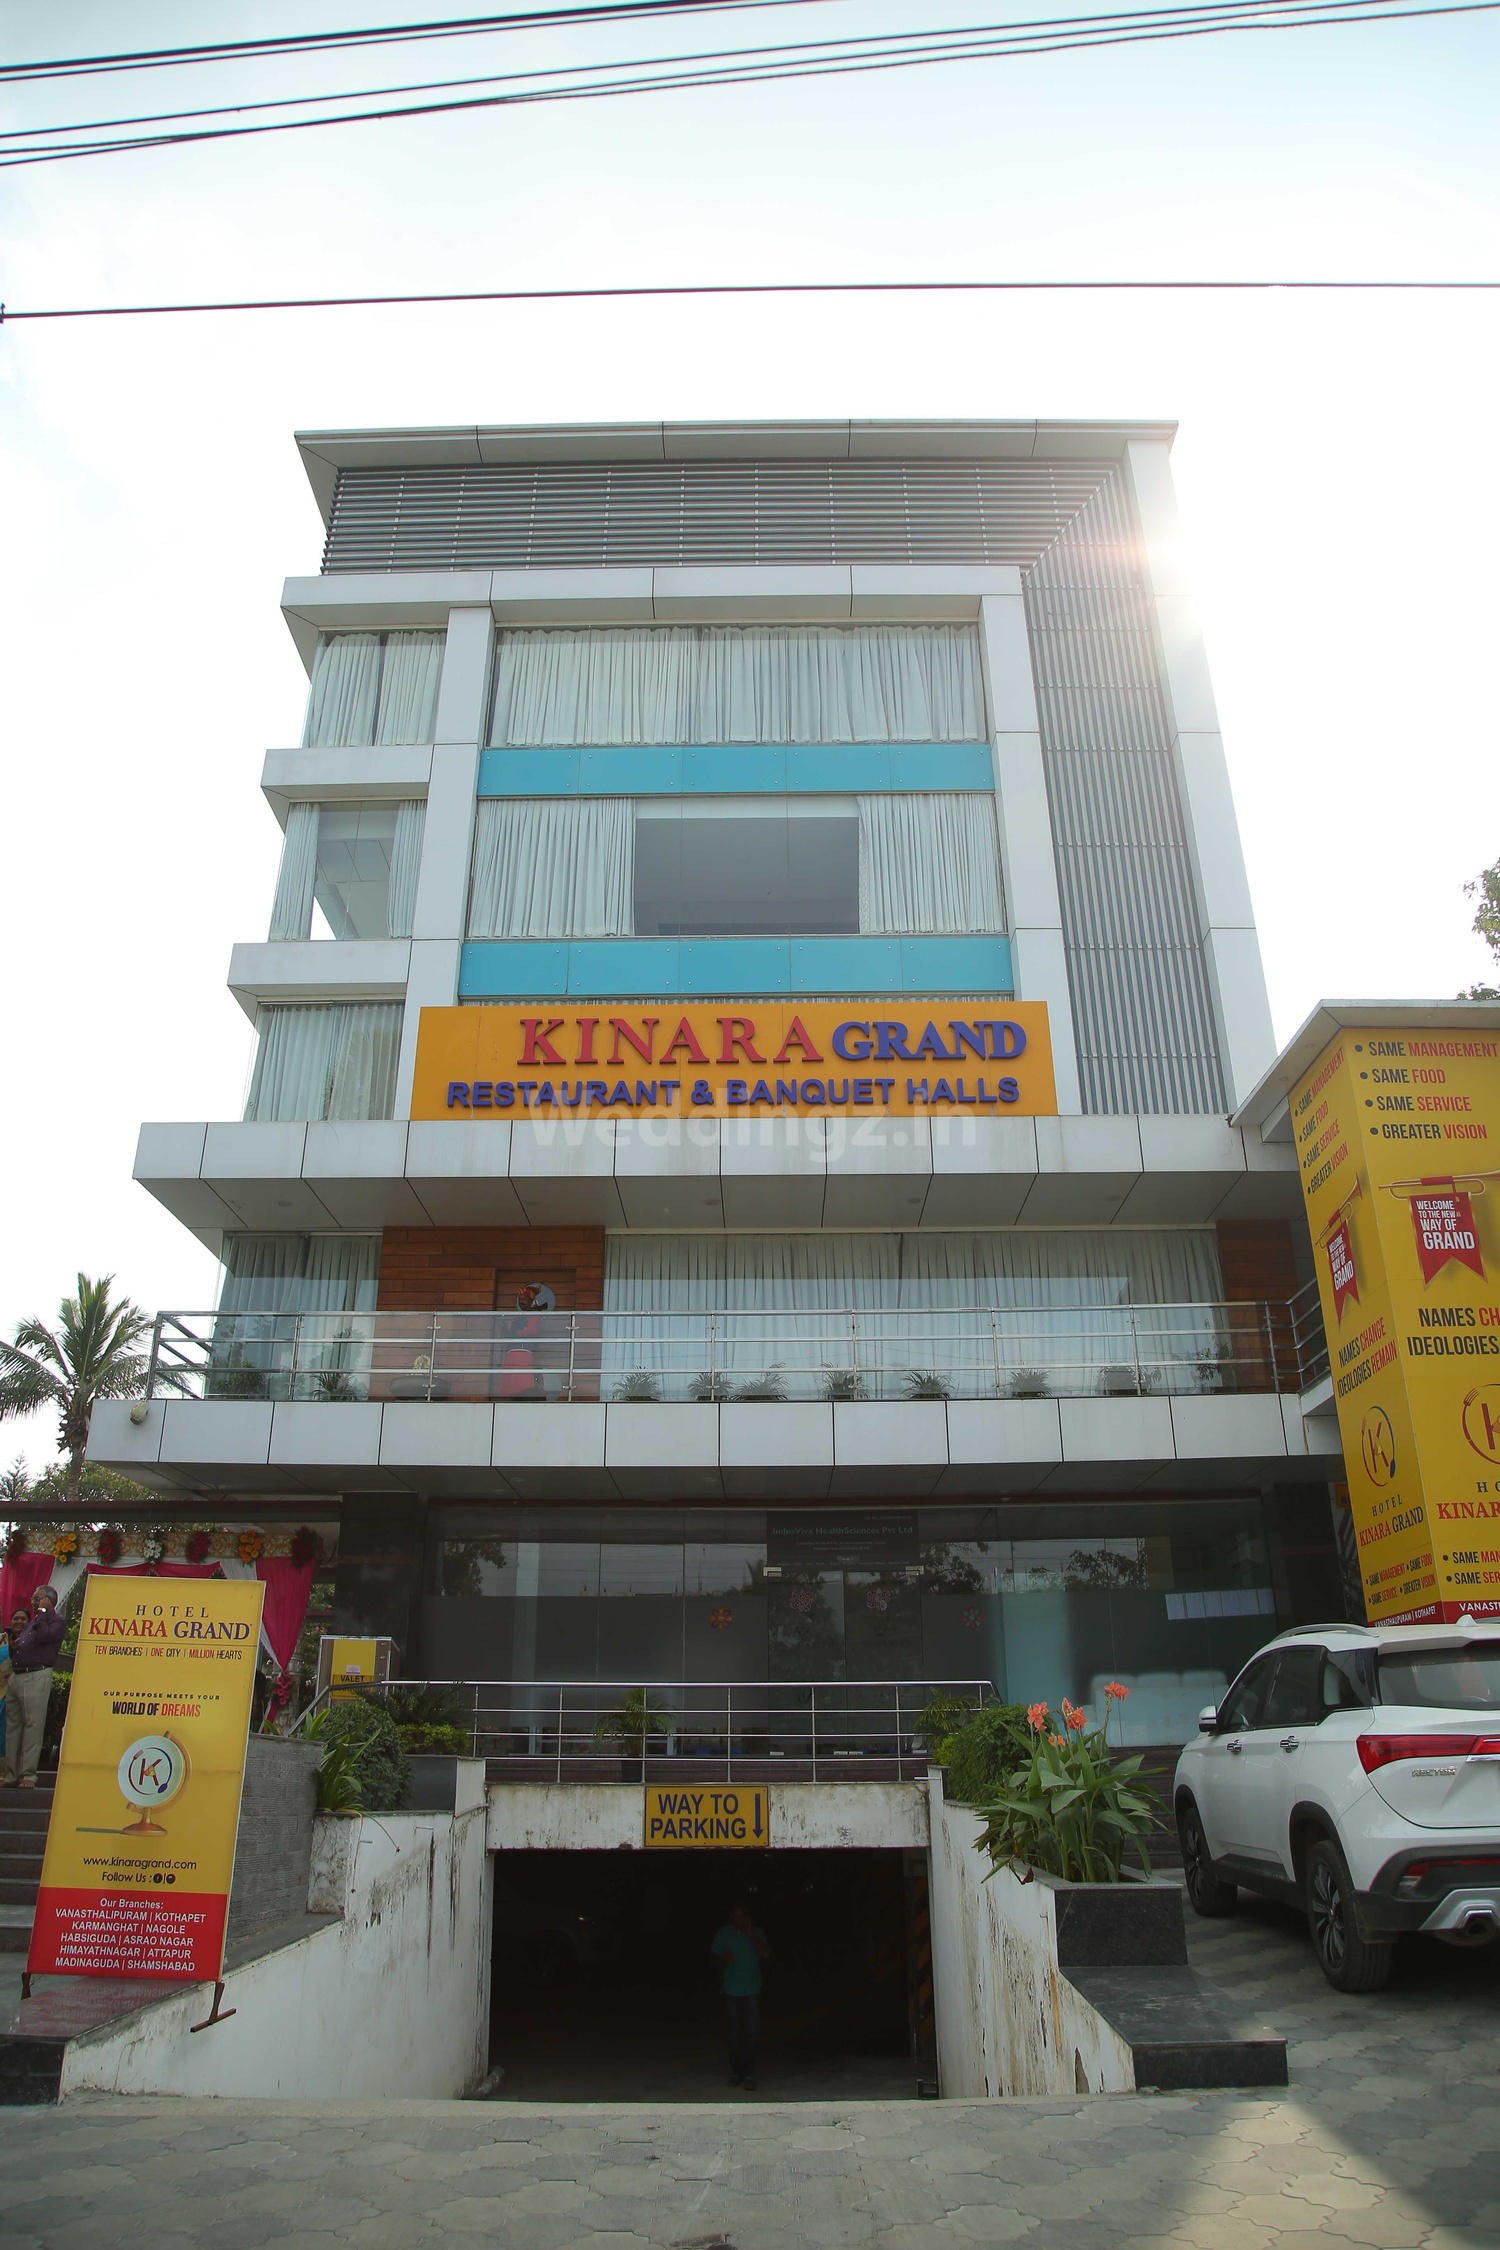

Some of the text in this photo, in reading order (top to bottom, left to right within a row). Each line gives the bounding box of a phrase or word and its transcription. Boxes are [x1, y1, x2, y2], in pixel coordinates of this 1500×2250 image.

[517, 1016, 1027, 1064] KINARA GRAND
[1368, 1042, 1498, 1057] SAME MANAGEMENT
[1298, 1046, 1344, 1114] SAME MANAGEMENT
[1372, 1069, 1446, 1084] SAME FOOD
[447, 1077, 1019, 1108] RESTAURANT & BANQUET HALLS
[1376, 1096, 1472, 1112] SAME SERVICE
[1302, 1100, 1329, 1141] SAME FOOD
[1382, 1124, 1488, 1139] GREATER VISION
[1306, 1118, 1340, 1167] SAME SERVICE
[1310, 1141, 1349, 1193] GREATER VISION
[1416, 1200, 1454, 1210] WELCOME
[1418, 1210, 1456, 1218] TO THE NEW
[1420, 1219, 1456, 1230] WAY OF
[1423, 1232, 1475, 1250] GRAND
[1333, 1260, 1354, 1290] GRAND
[1418, 1307, 1476, 1327] NAMES
[1338, 1316, 1386, 1368] NAMES CHANGE
[1407, 1336, 1500, 1356] IDEOLOGIES
[1337, 1340, 1398, 1398] IDEOLOGIES REMAIN
[1372, 1494, 1402, 1516] HOTEL
[772, 1527, 813, 1536] IndusViva
[816, 1526, 880, 1535] HealthSciences
[1359, 1506, 1424, 1546] KINARA GRAND
[1452, 1552, 1479, 1564] SAME
[1369, 1553, 1432, 1586] SAME MANAGEMENT SAME FOOD
[1454, 1572, 1482, 1584] SAME
[1371, 1574, 1435, 1604] SAME SERVICE GREATER VISION
[136, 1605, 209, 1618] HOTEL
[1415, 1606, 1436, 1618] KOTHAPET
[88, 1618, 250, 1640] KINARA GRAND
[95, 1646, 242, 1660] TEN BRANCHES ONE CITY MILLION HEARTS
[112, 1701, 200, 1717] WORLD OF DREAMS
[658, 1794, 738, 1814] WAY TO
[650, 1818, 746, 1839] PARKING
[84, 1857, 197, 1870] www.kinaragrand.com
[102, 1872, 147, 1883] Follow Us
[100, 1898, 164, 1909] Our Branches:
[55, 1909, 206, 1923] VANASTHALIPURAM KOTHAPET
[72, 1921, 186, 1934] KARMANGHAT NAGOLE
[60, 1933, 194, 1947] HABSIGUDA ASRAO NAGAR
[60, 1945, 191, 1958] HIMAYATHNAGAR ATTAPUR
[55, 1958, 195, 1972] MADINAGUDA SHAMSHABAD
